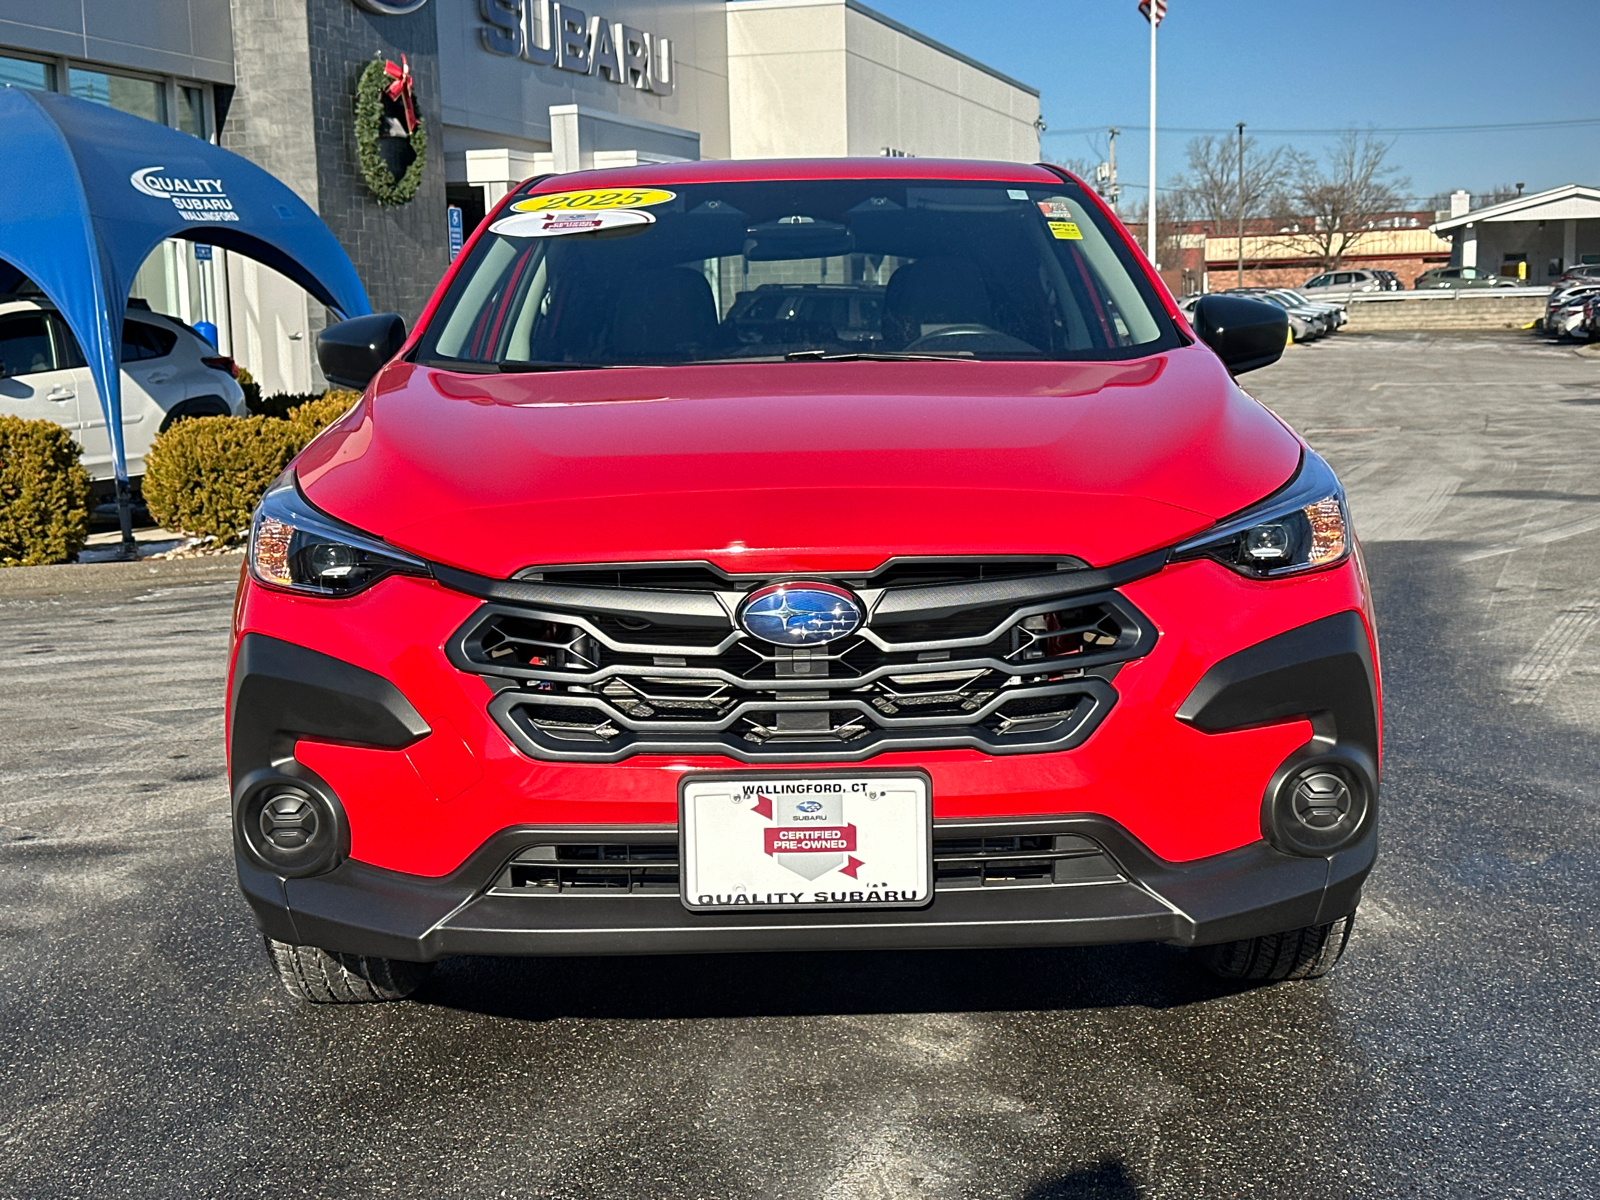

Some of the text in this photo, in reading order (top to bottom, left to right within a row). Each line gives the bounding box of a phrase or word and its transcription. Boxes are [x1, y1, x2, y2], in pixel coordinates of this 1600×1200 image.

[477, 0, 675, 96] SUBARU
[145, 175, 223, 193] QUALITY
[171, 197, 233, 211] SUBARU
[536, 191, 651, 211] 2025
[178, 210, 240, 221] WALLINGFORD
[742, 782, 868, 795] WALLINGFORD, CT
[779, 830, 841, 840] CERTIFIED
[773, 839, 848, 850] PRE-OWNED
[697, 889, 918, 905] QUALITY SUBARU
